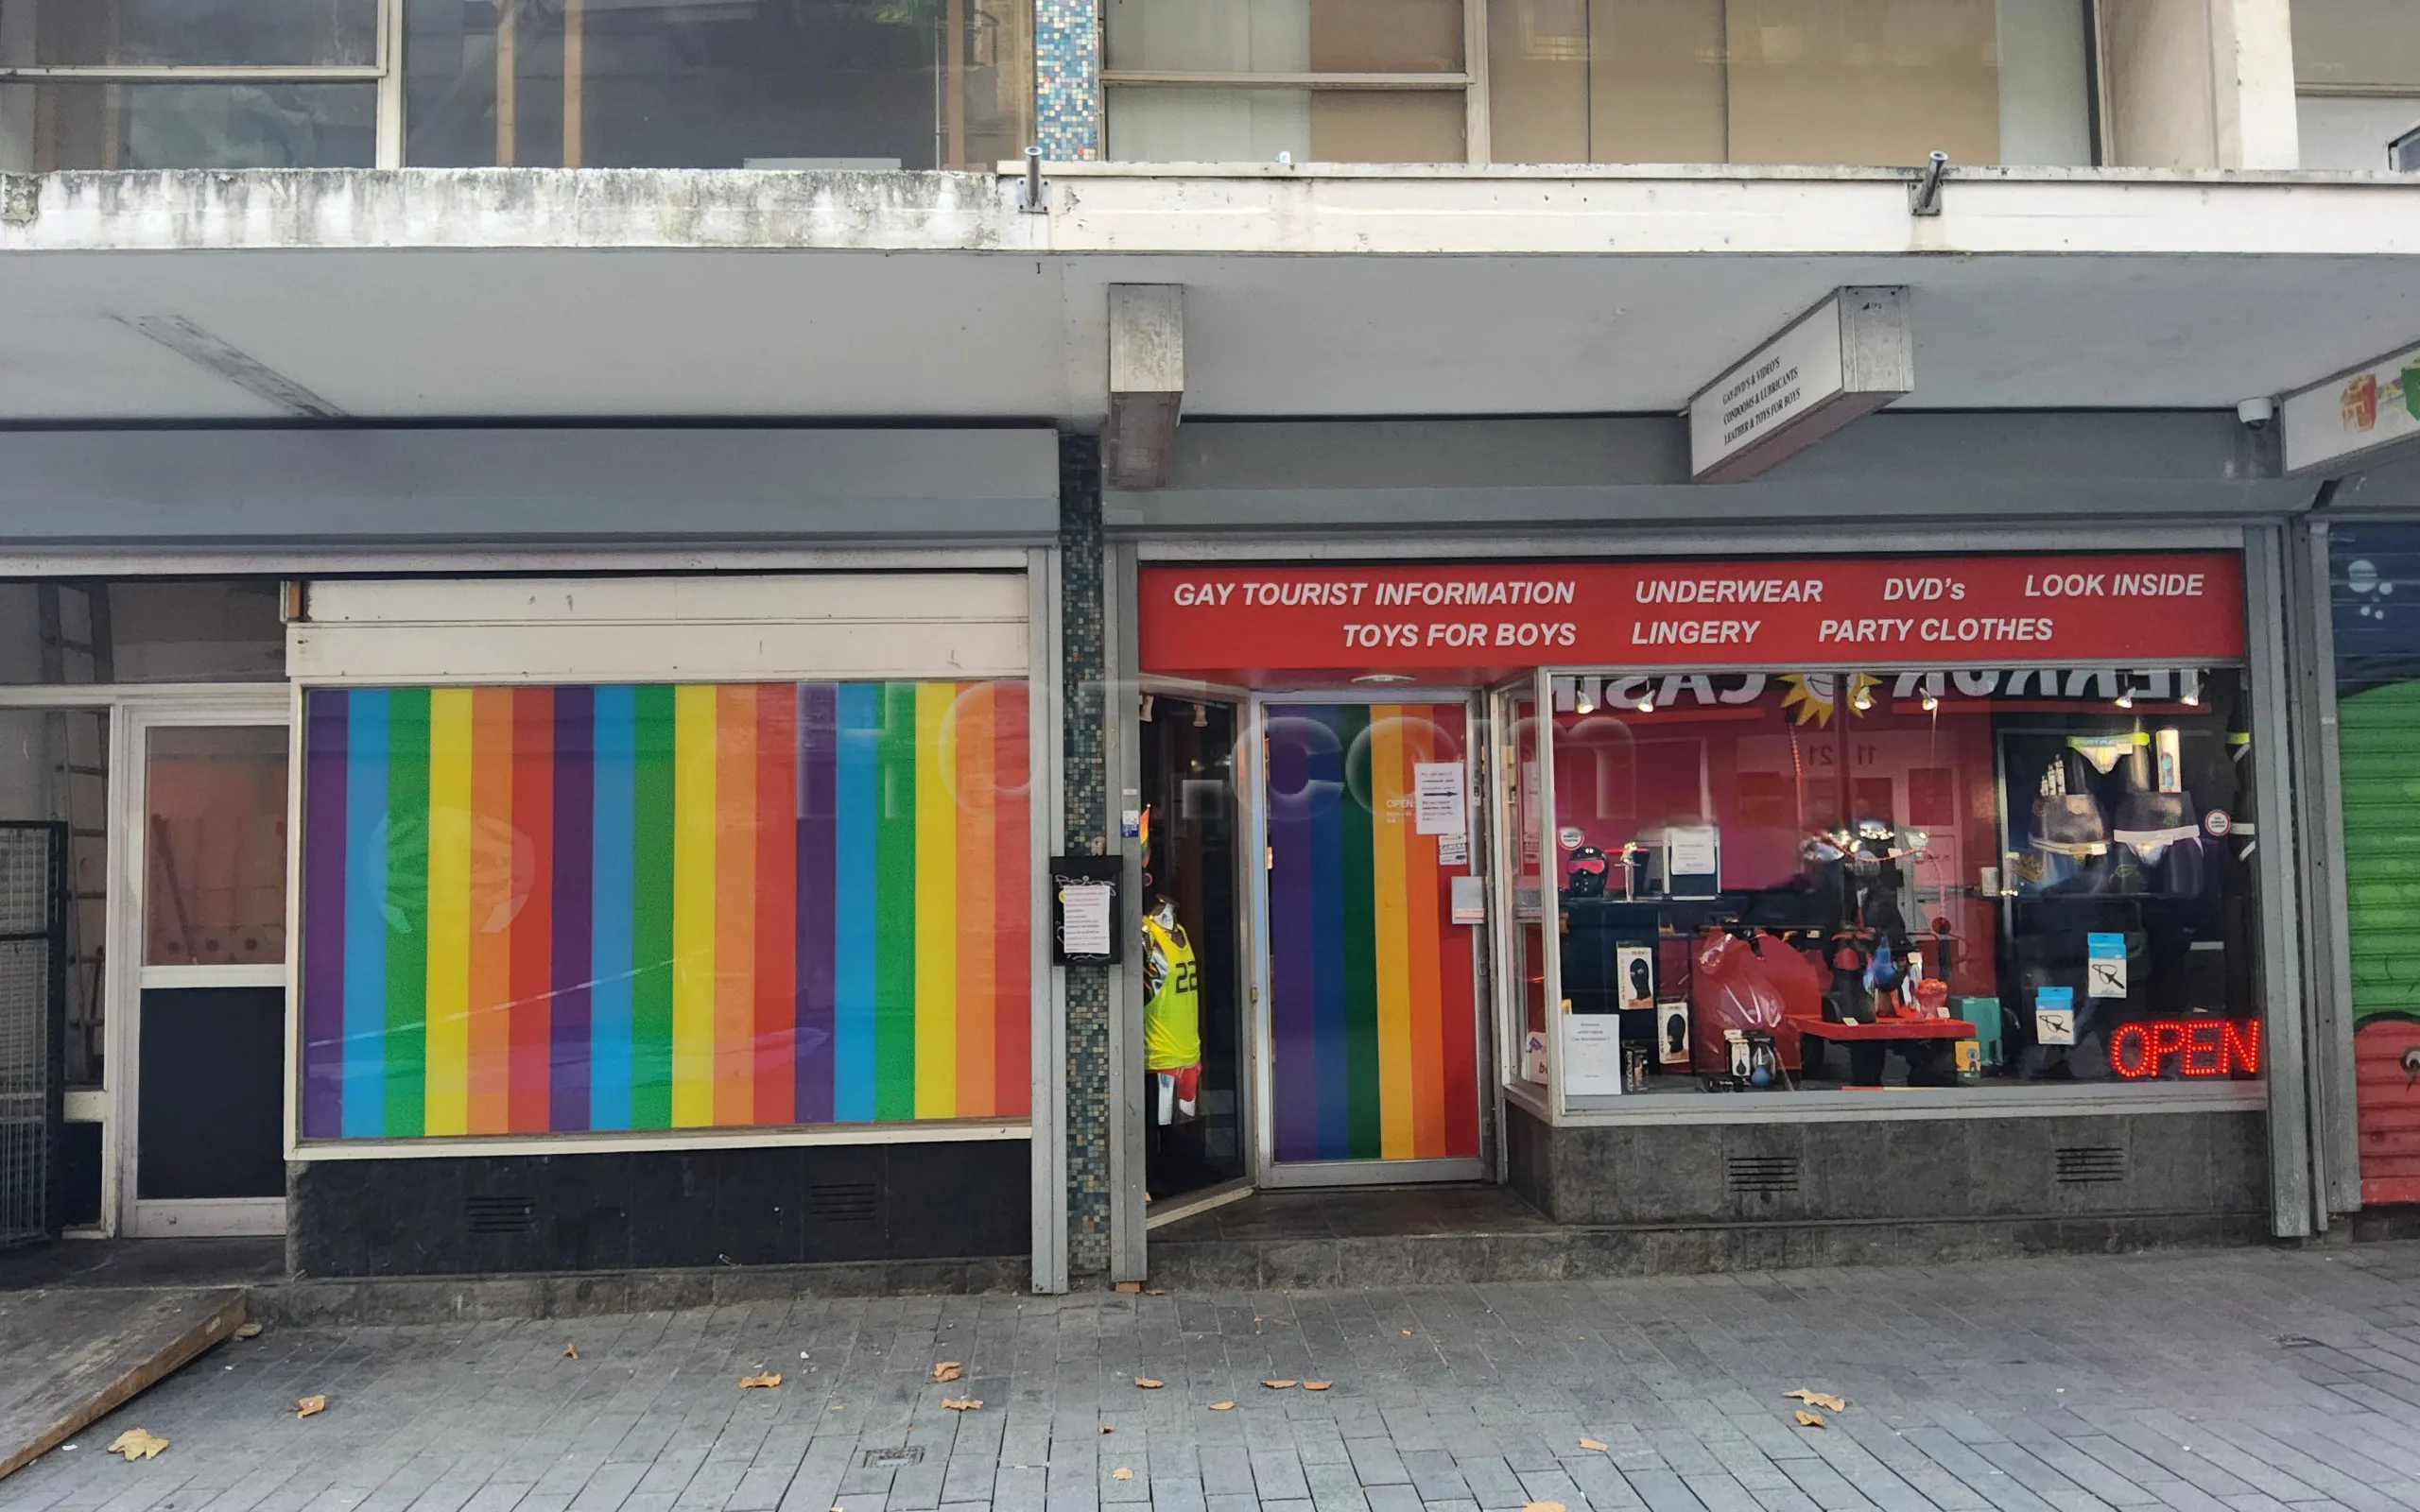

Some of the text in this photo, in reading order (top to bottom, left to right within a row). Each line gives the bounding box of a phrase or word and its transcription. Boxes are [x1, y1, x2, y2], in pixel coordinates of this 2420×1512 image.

[1760, 366, 1799, 401] LUBRICANTS
[1723, 421, 1749, 446] LEATHER
[1754, 407, 1771, 425] TOYS
[1771, 399, 1784, 416] FOR
[1784, 387, 1801, 407] BOYS
[1173, 580, 1576, 607] GAY TOURIST INFORMATION
[1635, 578, 1824, 604] UNDERWEAR
[1883, 577, 1966, 601] DVD's
[2025, 573, 2205, 597] LOOK INSIDE
[1343, 622, 1577, 647] TOYS FOR BOYS
[1632, 619, 1762, 644] LINGERY
[1819, 617, 2054, 643] PARTY CLOTHES
[1175, 960, 1198, 993] 22
[2112, 1020, 2259, 1077] OPEN
